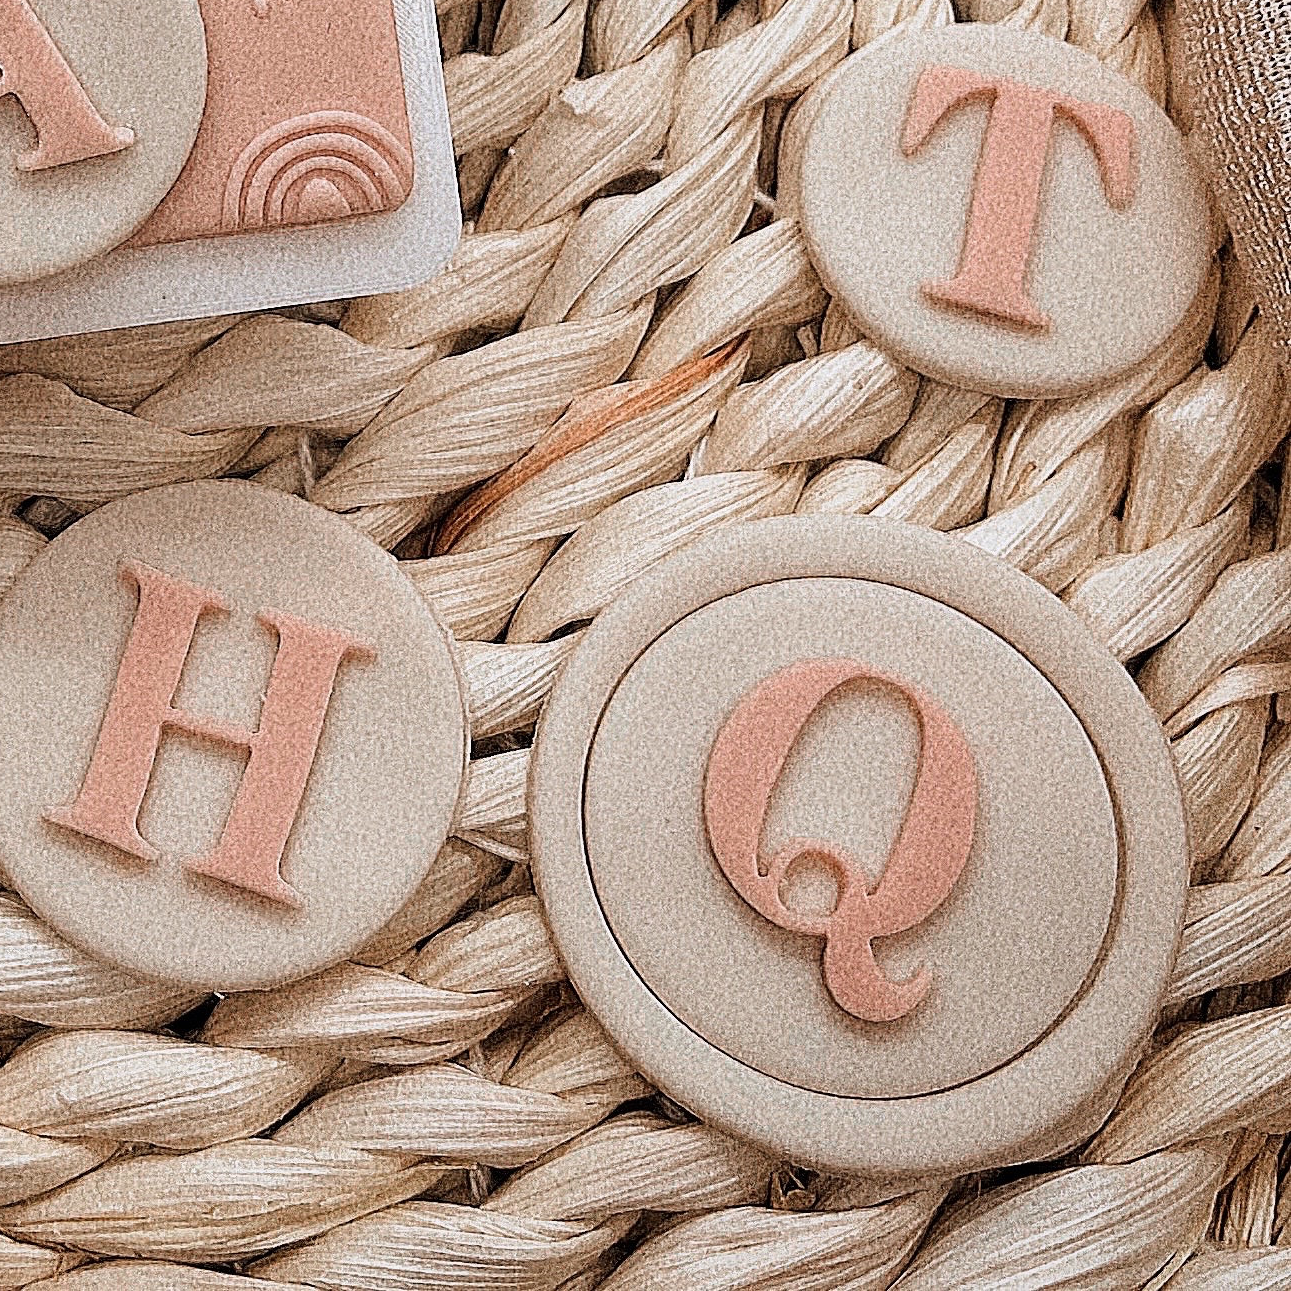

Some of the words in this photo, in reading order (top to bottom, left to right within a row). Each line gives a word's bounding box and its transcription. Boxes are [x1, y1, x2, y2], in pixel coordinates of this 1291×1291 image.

[902, 66, 1133, 333] T
[41, 560, 376, 909] H
[708, 657, 978, 1024] Q
